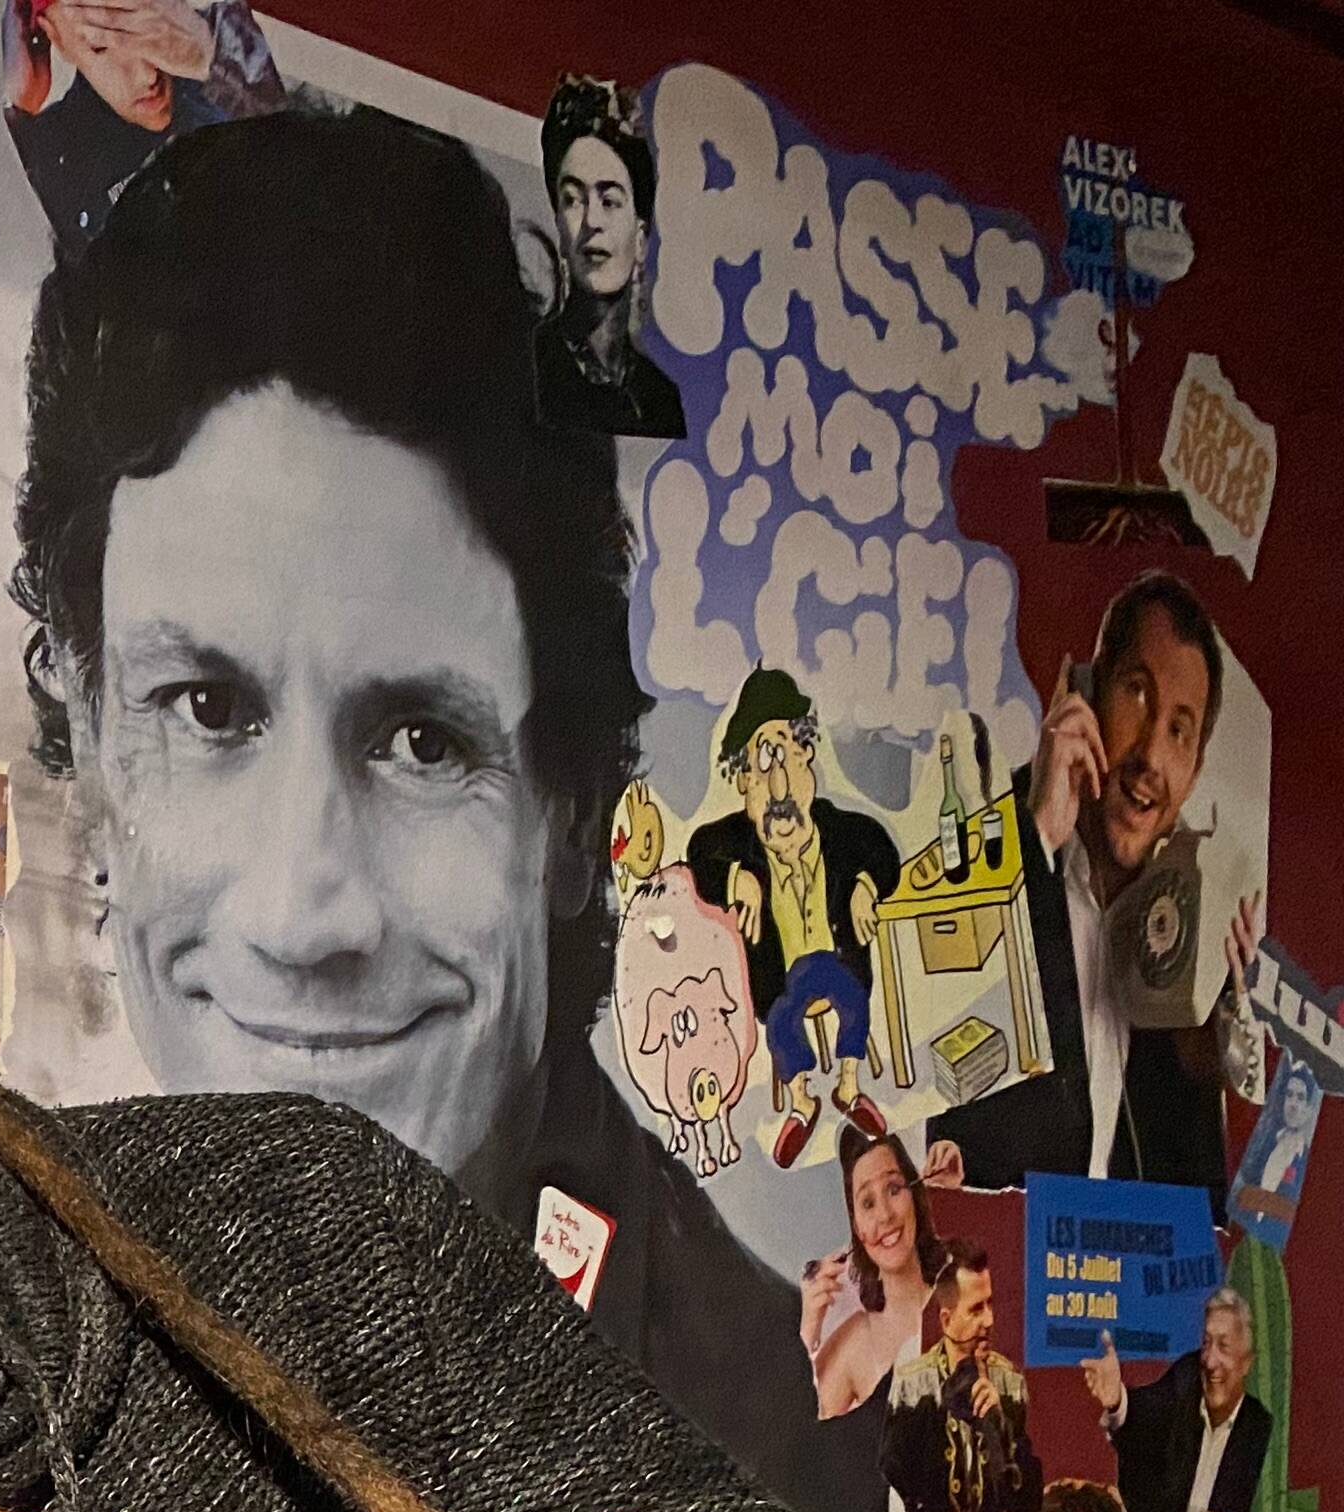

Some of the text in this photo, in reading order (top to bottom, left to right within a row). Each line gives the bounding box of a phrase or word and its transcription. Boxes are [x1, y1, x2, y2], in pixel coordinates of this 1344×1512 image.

[1062, 134, 1132, 181] ALEX
[1063, 174, 1188, 234] VIZOREK
[653, 62, 1050, 449] PASSE
[1067, 1253, 1077, 1280] 5
[1079, 1254, 1122, 1283] Juillet
[1046, 1292, 1065, 1317] au
[1066, 1291, 1085, 1318] 30
